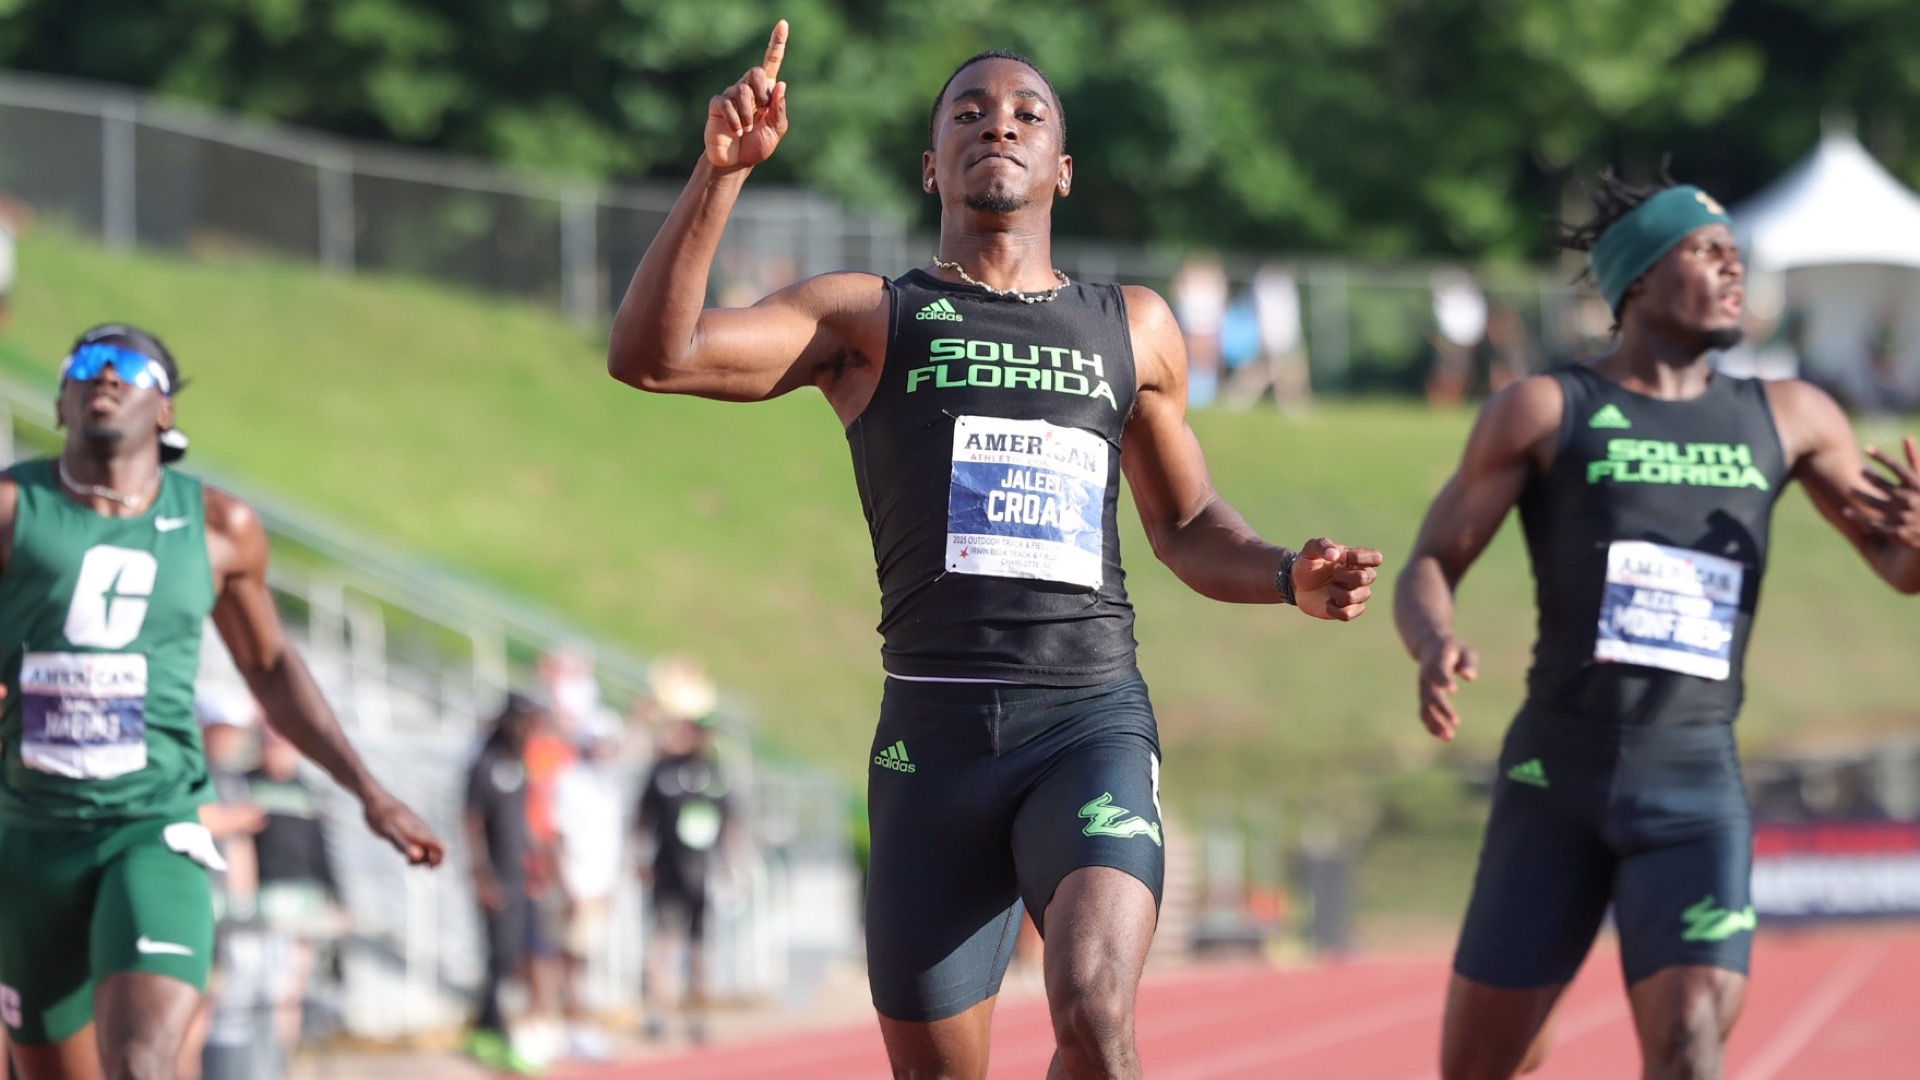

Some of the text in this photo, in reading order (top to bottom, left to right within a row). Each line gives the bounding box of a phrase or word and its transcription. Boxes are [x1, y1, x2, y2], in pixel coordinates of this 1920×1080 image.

[915, 311, 963, 322] adidas
[929, 338, 1104, 377] SOUTH
[906, 364, 1118, 411] FLORIDA
[964, 433, 1097, 473] AMERCAN
[1607, 438, 1751, 466] SOUTH
[1586, 460, 1770, 491] FLORIDA
[968, 536, 1000, 546] OUTDOOR
[1001, 538, 1024, 548] TRACK
[63, 544, 158, 650] C
[874, 756, 916, 772] adidas
